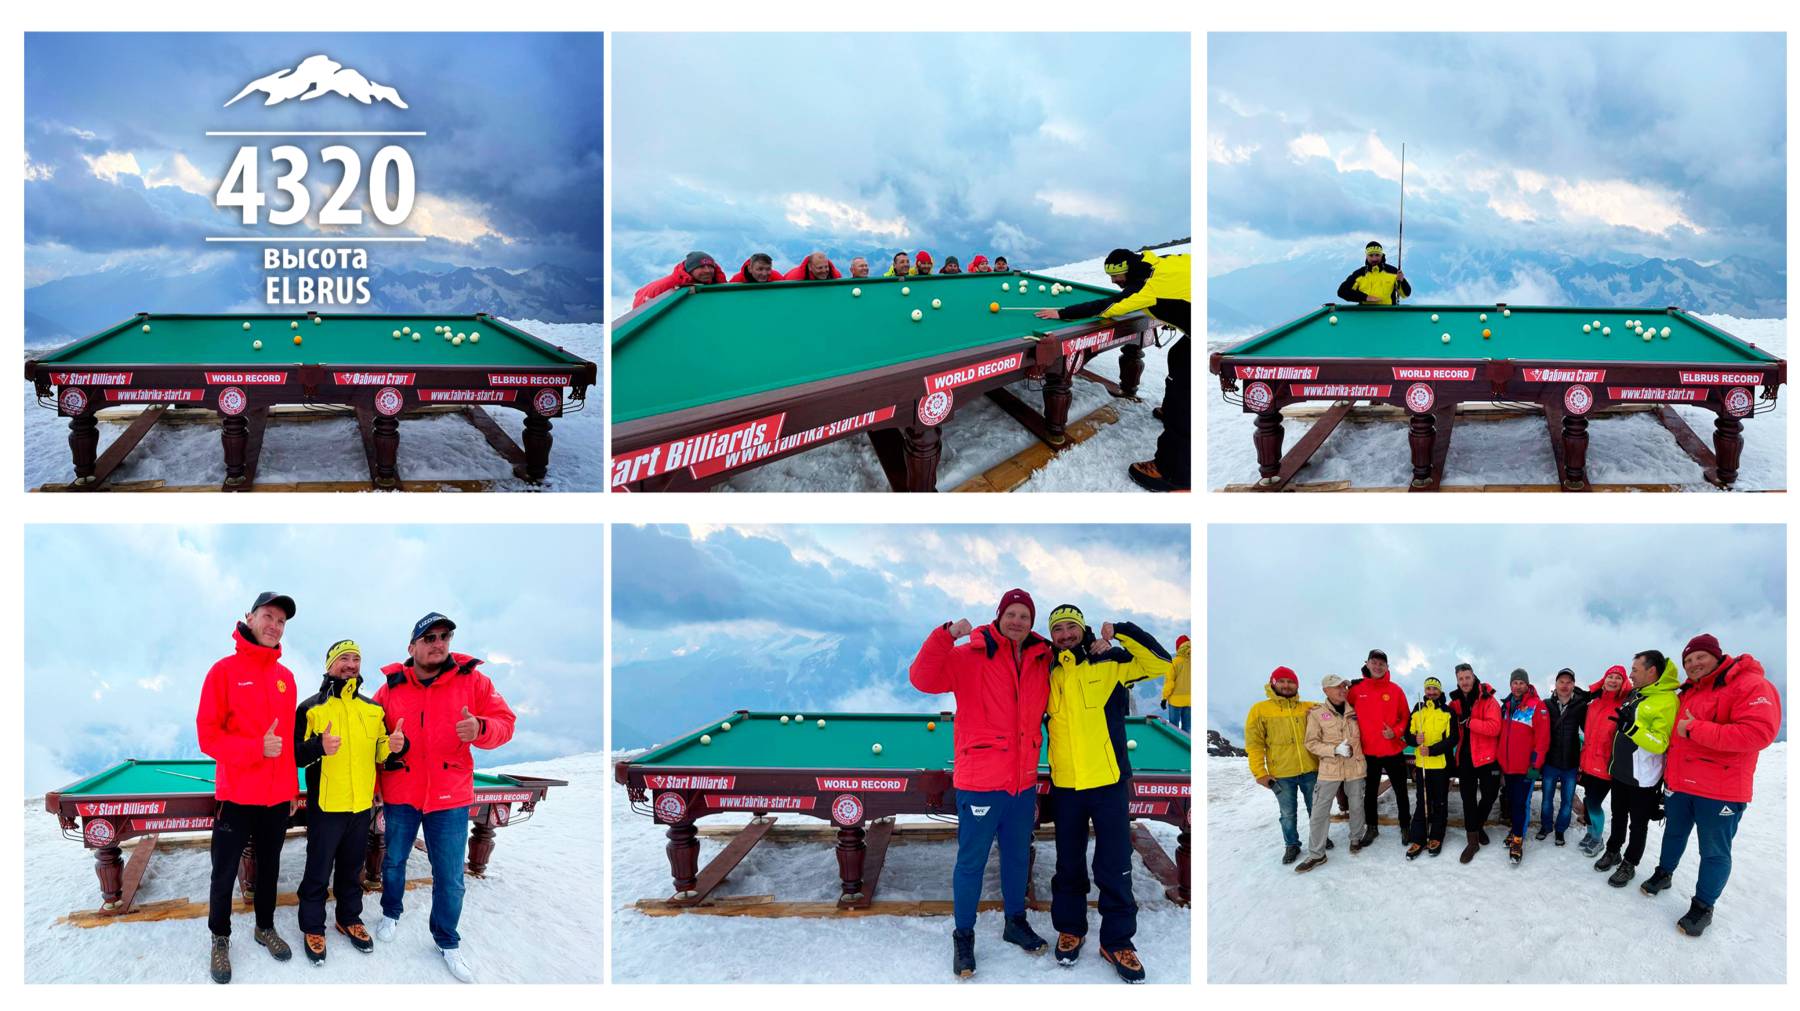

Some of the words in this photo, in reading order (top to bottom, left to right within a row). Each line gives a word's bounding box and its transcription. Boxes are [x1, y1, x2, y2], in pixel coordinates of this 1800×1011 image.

[69, 373, 91, 385] Start
[92, 372, 126, 385] Billiards
[212, 374, 243, 383] WORLD
[245, 374, 281, 383] RECORD
[352, 373, 387, 385] Фабрика
[388, 374, 408, 385] Старт
[934, 368, 975, 389] WORLD
[977, 358, 1016, 377] RECORD
[1254, 367, 1276, 380] Start
[1277, 366, 1312, 380] Billiards
[1399, 369, 1431, 378] WORLD
[1433, 369, 1469, 378] RECORD
[1542, 369, 1575, 381] Фабрика
[1576, 370, 1598, 381] Старт
[1683, 373, 1719, 382] ELBRUS
[1721, 374, 1760, 383] RECORD
[492, 375, 528, 384] ELBRUS
[530, 376, 568, 385] RECORD
[117, 389, 192, 401] www.fabrika-start.ru
[430, 390, 504, 401] www.fabrika-start.ru
[1303, 384, 1379, 397] www.fabrika-start.ru
[1620, 388, 1695, 400] www.fabrika-start.ru
[664, 422, 768, 472] Billiards
[666, 776, 689, 789] Start
[690, 777, 728, 789] Billiards
[824, 779, 859, 789] WORLD
[861, 780, 901, 789] RECORD
[1138, 785, 1178, 795] ELBRUS
[502, 793, 530, 801] RECORD
[719, 796, 801, 808] www.fabrika-start.ru
[98, 803, 121, 816] Start
[122, 802, 159, 815] Billiards
[145, 818, 214, 830] www.fabrika-start.r
